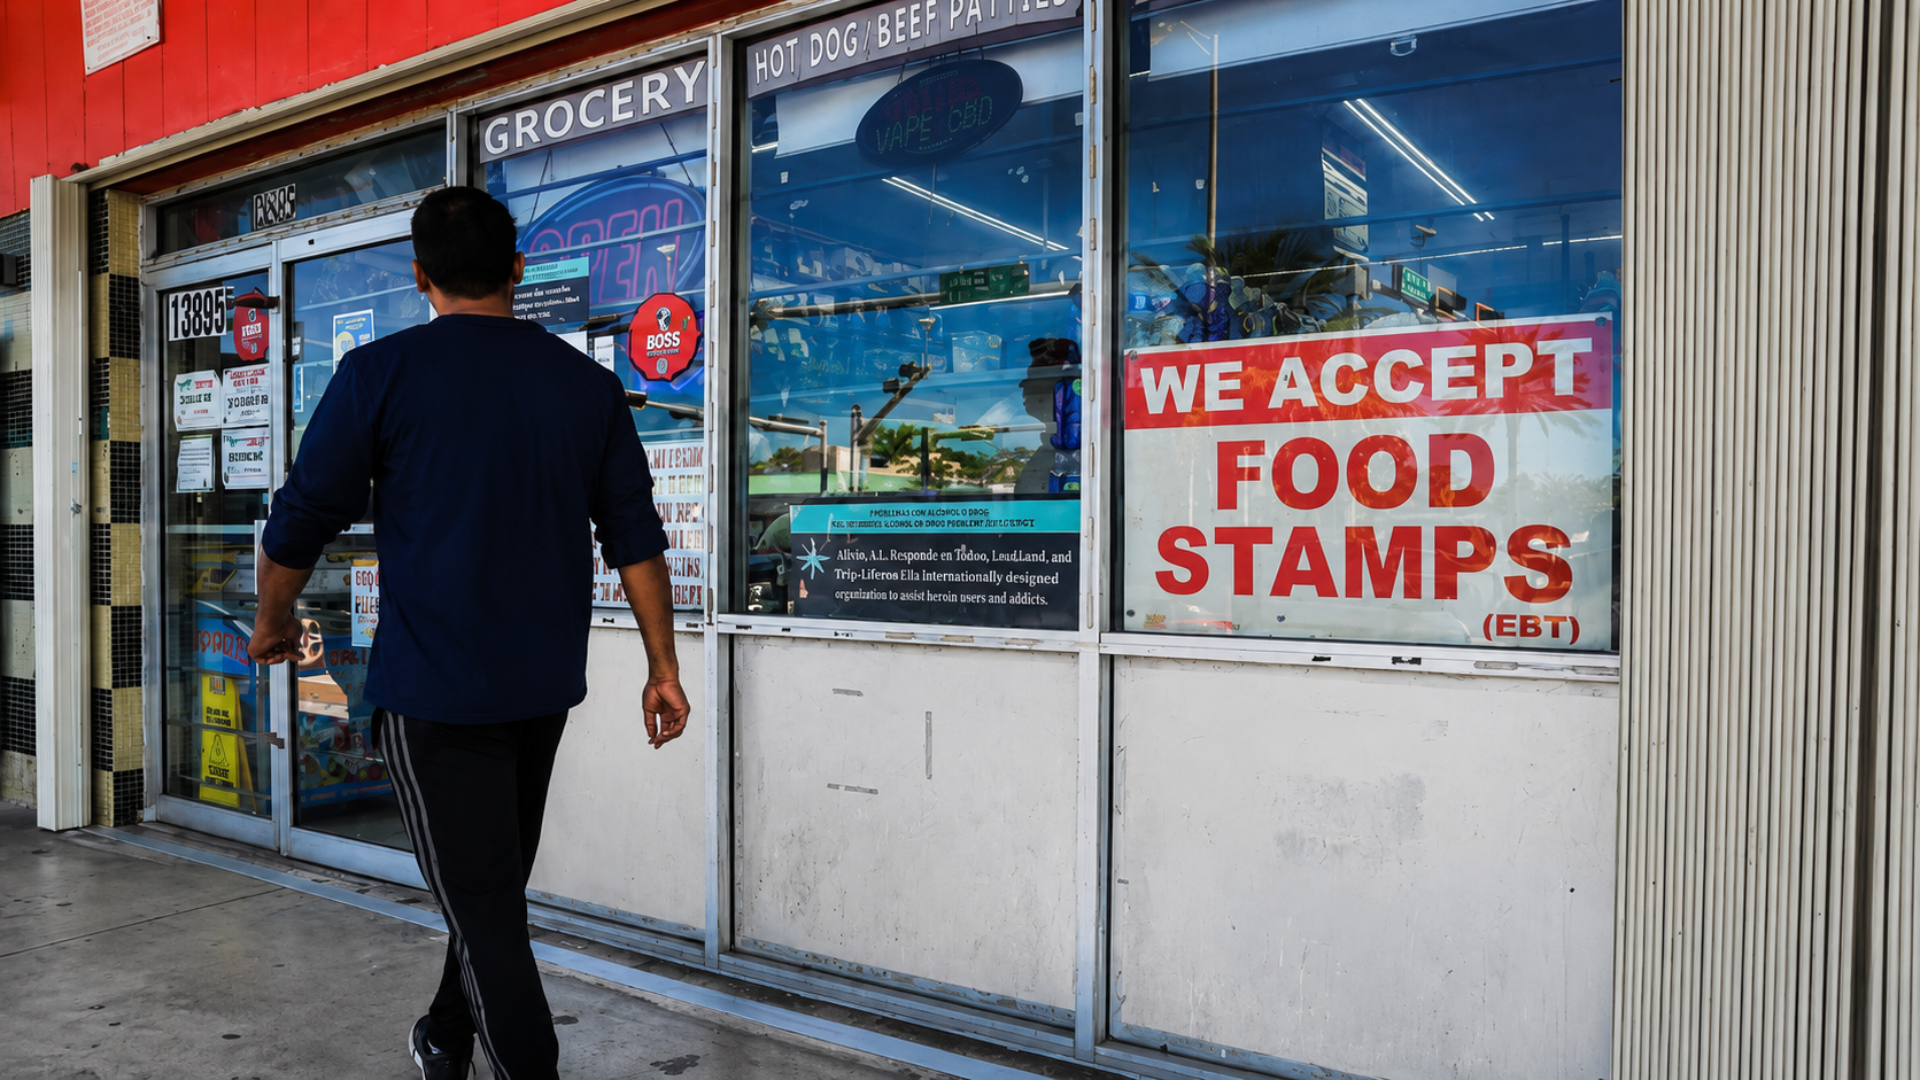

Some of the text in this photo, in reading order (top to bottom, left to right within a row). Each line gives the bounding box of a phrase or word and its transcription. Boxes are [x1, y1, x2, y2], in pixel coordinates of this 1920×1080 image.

[755, 37, 798, 85] HOT
[484, 60, 706, 156] GROCERY
[876, 107, 933, 155] VAPE
[947, 95, 993, 133] CBD
[171, 288, 226, 339] 13895
[647, 331, 681, 351] BOSS
[1140, 337, 1593, 415] WE ACCEPT
[1216, 433, 1495, 510] FOOD
[836, 547, 868, 563] Alivio,
[890, 548, 938, 565] Responde
[940, 551, 953, 561] en
[1051, 550, 1072, 563] and
[900, 569, 920, 581] Ella
[1005, 571, 1060, 587] designed
[1155, 524, 1573, 603] STAMPS
[889, 590, 899, 600] to
[899, 589, 926, 601] assist
[926, 589, 958, 602] heroin
[960, 593, 986, 604] users
[988, 591, 1007, 604] and
[1009, 591, 1049, 606] addicts.
[1483, 613, 1581, 646] (EBT)
